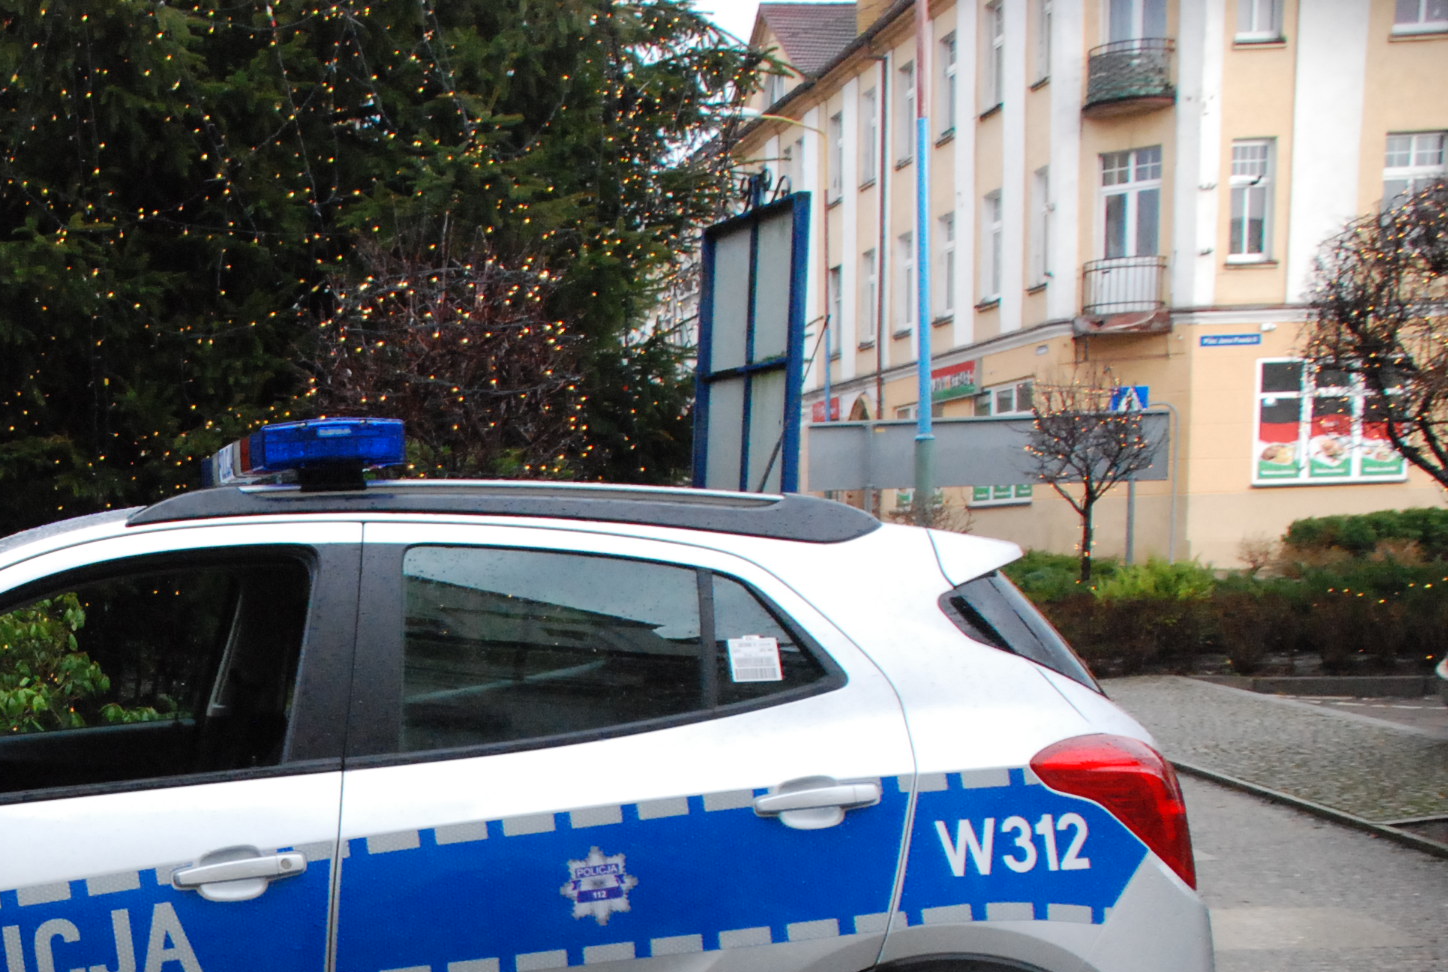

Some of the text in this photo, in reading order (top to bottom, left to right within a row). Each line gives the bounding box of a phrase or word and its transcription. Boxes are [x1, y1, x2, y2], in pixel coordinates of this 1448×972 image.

[934, 812, 1092, 877] W312
[577, 864, 618, 878] POLICJA
[593, 890, 607, 899] 112
